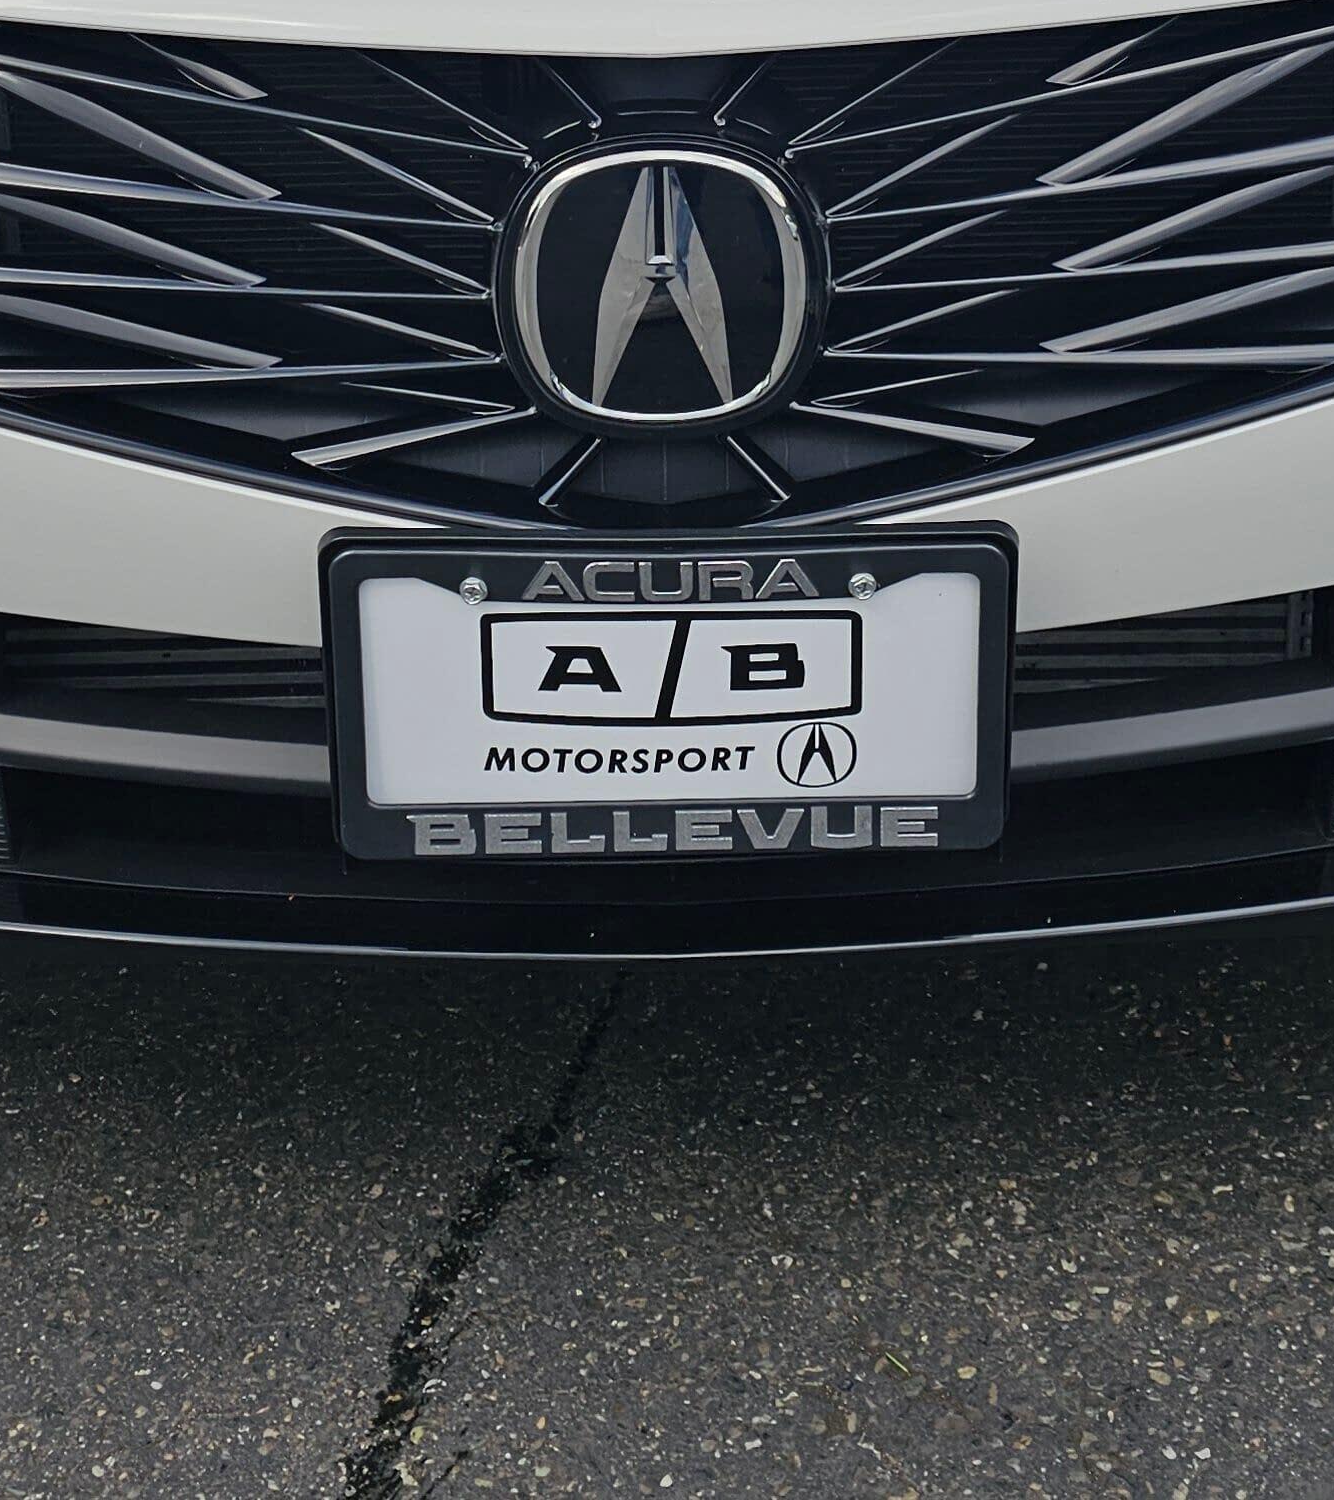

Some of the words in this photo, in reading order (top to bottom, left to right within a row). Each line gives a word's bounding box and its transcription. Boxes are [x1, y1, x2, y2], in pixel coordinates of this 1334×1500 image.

[523, 559, 820, 602] ACURA
[538, 645, 623, 693] A
[722, 642, 805, 691] B
[483, 744, 756, 775] MOTORSPORT
[405, 805, 939, 856] BELLEVUE
